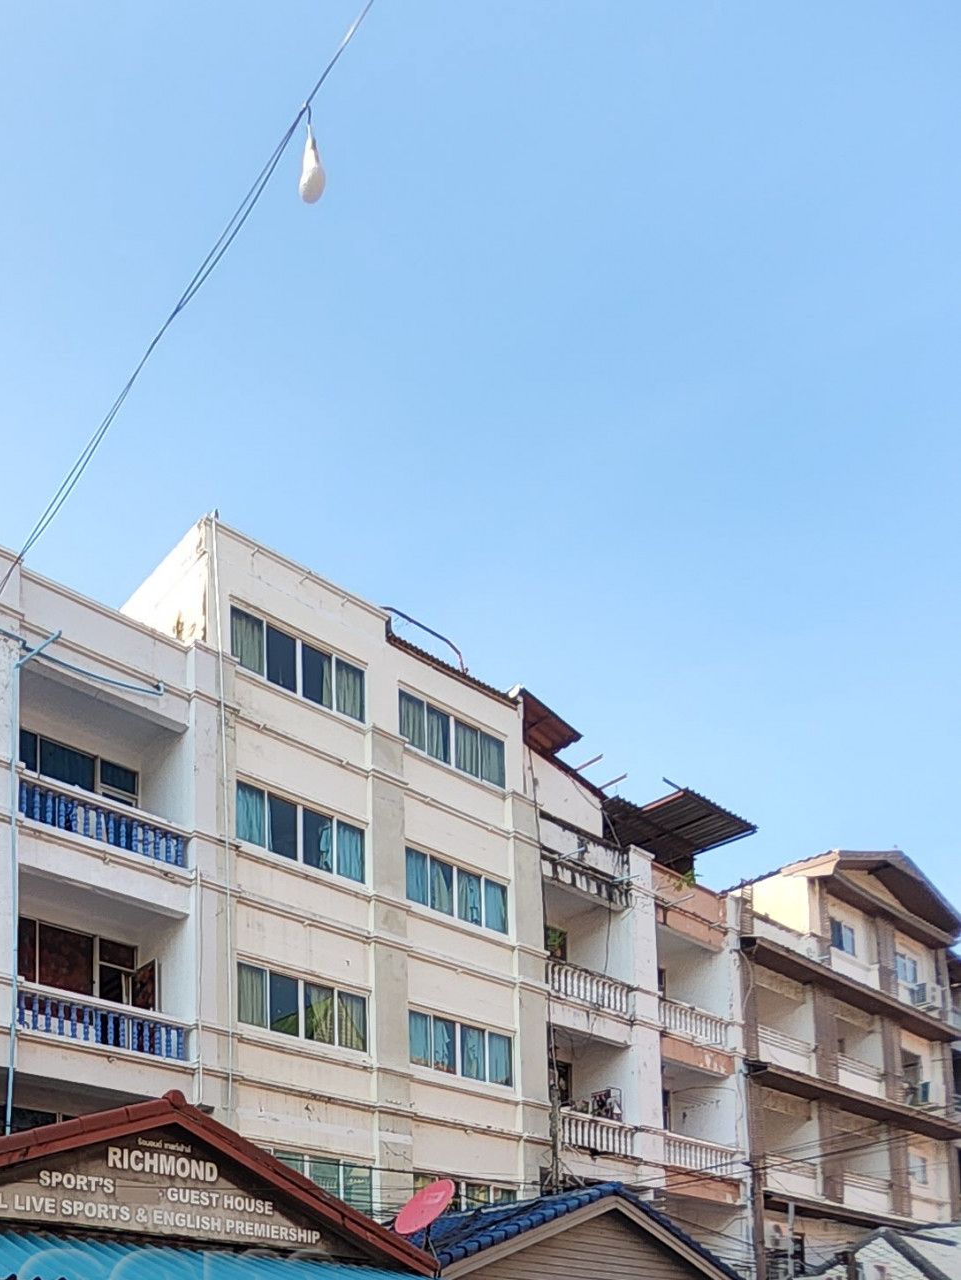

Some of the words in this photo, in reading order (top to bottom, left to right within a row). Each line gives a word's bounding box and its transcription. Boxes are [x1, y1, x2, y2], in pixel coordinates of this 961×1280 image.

[106, 1146, 219, 1183] RICHMOND
[39, 1170, 115, 1194] SPORT'S
[166, 1187, 220, 1209] GUEST
[223, 1194, 274, 1216] HOUSE
[14, 1195, 56, 1215] LIVE
[61, 1200, 131, 1223] SPORTS
[135, 1206, 148, 1224] &
[153, 1210, 223, 1233] ENGLISH
[225, 1219, 321, 1245] PREMIERSHIP
